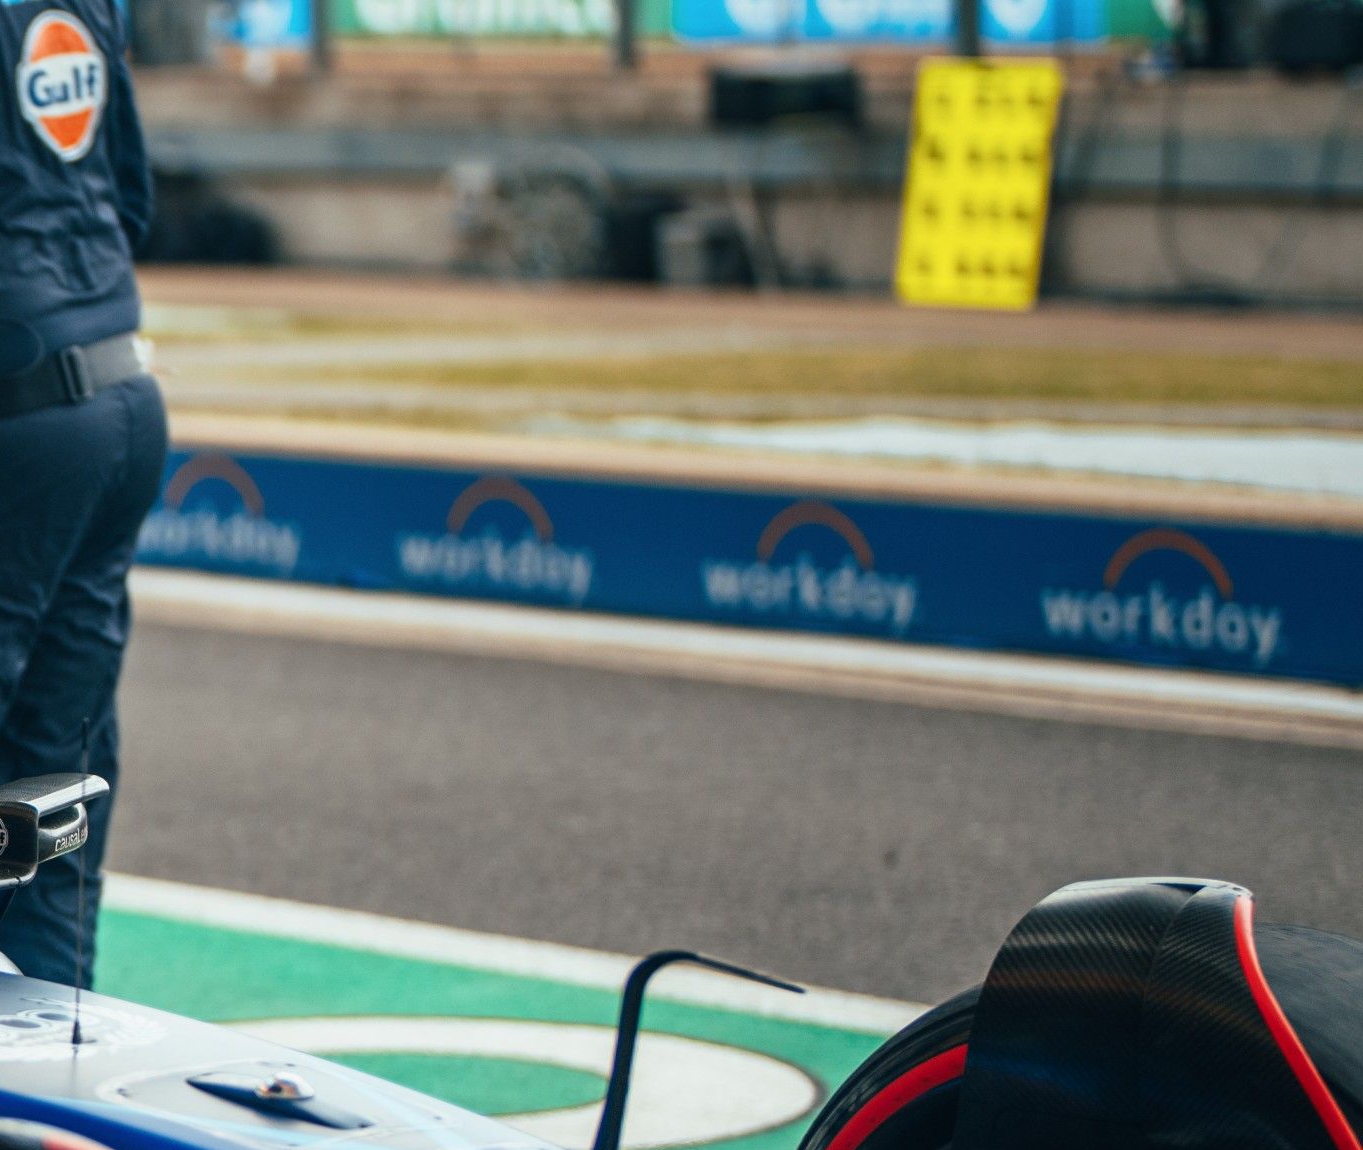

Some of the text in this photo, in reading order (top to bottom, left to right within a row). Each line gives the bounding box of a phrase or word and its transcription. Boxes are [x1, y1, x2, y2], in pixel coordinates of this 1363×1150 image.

[27, 63, 99, 108] Gulf
[701, 554, 916, 632] workday
[1041, 583, 1280, 663] workday
